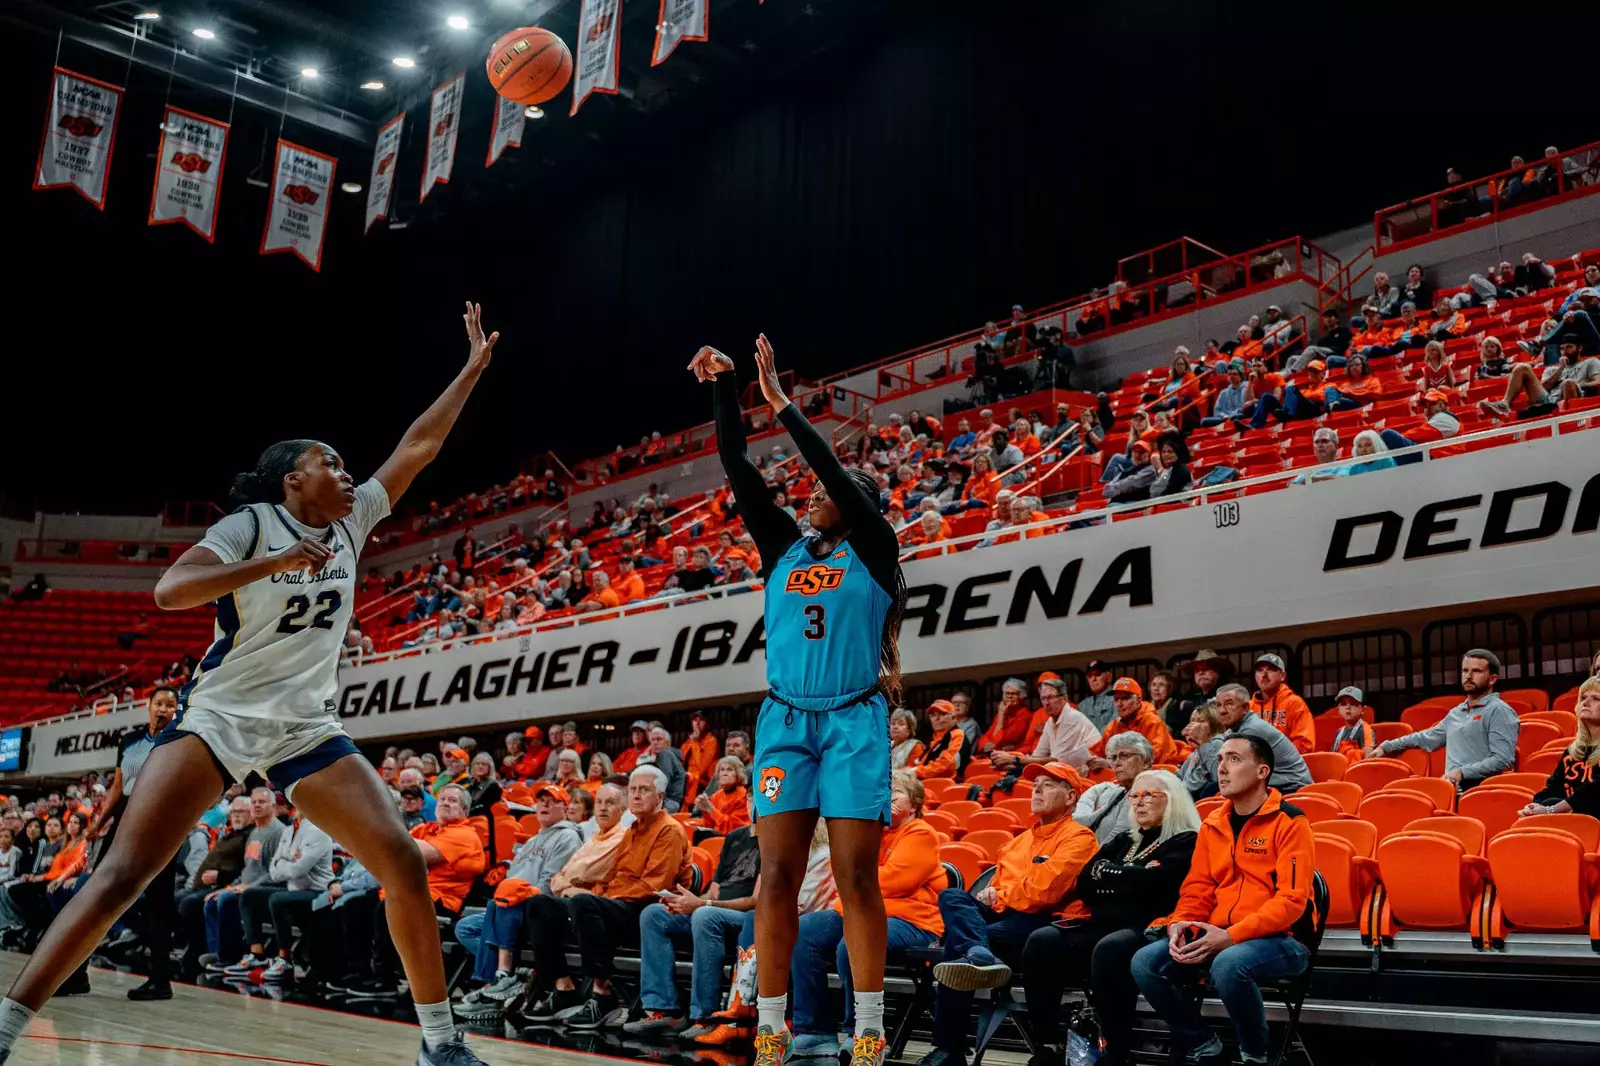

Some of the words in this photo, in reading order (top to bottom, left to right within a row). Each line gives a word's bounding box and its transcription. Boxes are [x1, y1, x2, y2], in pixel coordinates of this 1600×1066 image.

[57, 91, 113, 115] CHAMPIONS
[65, 142, 90, 156] 1937
[168, 131, 220, 151] HAMPIONS
[54, 159, 93, 175] WRESTLING
[57, 152, 92, 167] COWBOY
[170, 151, 212, 174] OSU
[294, 156, 318, 170] NCAA
[281, 161, 328, 183] CHAMPIONS
[167, 194, 204, 210] WRESTLING
[170, 187, 202, 203] COWBOY
[287, 208, 309, 222] 1939
[282, 218, 310, 233] COWBOY
[1213, 501, 1240, 528] 103
[271, 570, 305, 585] Oral
[785, 564, 847, 596] OSU
[898, 545, 1154, 638] RENA
[276, 590, 342, 634] 22
[803, 604, 826, 641] 3
